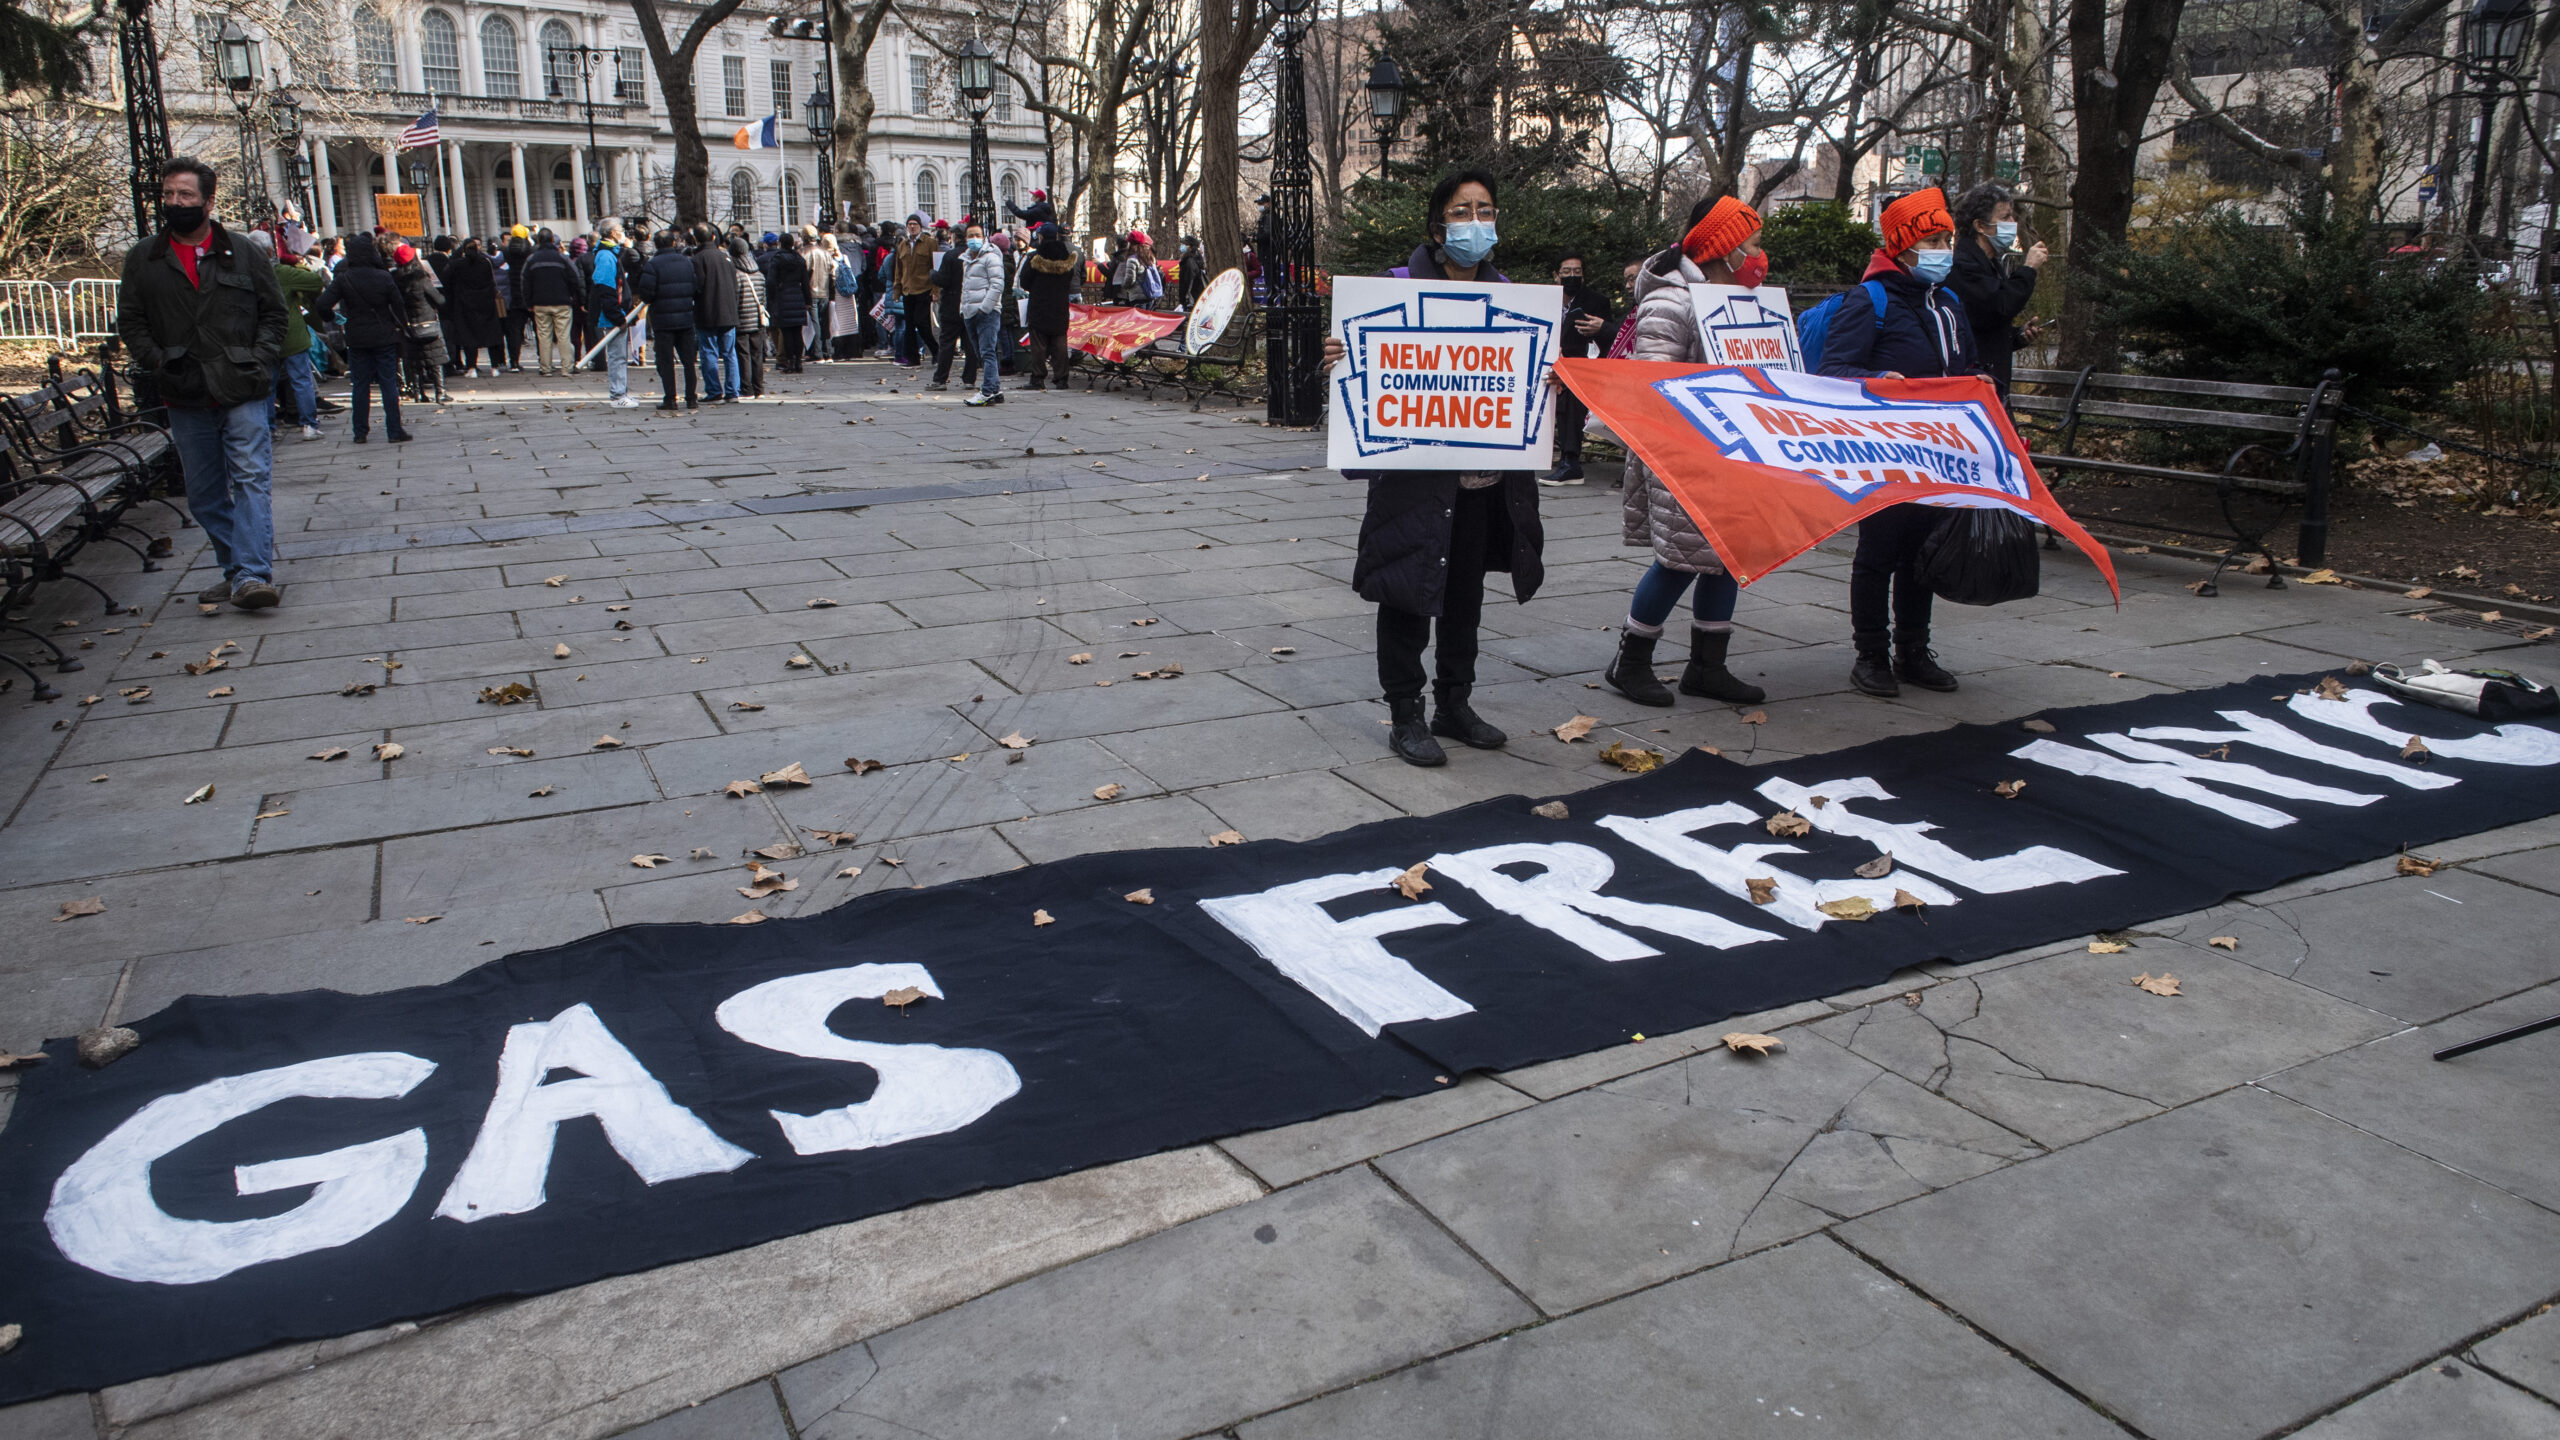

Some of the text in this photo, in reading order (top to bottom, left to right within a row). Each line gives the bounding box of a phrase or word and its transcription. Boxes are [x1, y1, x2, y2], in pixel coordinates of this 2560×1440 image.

[1380, 343, 1514, 372] NEW YORK
[1723, 338, 1785, 360] NEW YORK
[1381, 373, 1516, 393] COMMUNITIES FOR
[1376, 394, 1513, 429] CHANGE
[1745, 403, 1978, 454] NEW YORK
[1778, 440, 1970, 484] COMMUNITIES
[43, 688, 2560, 1284] GAS FREE NYC
